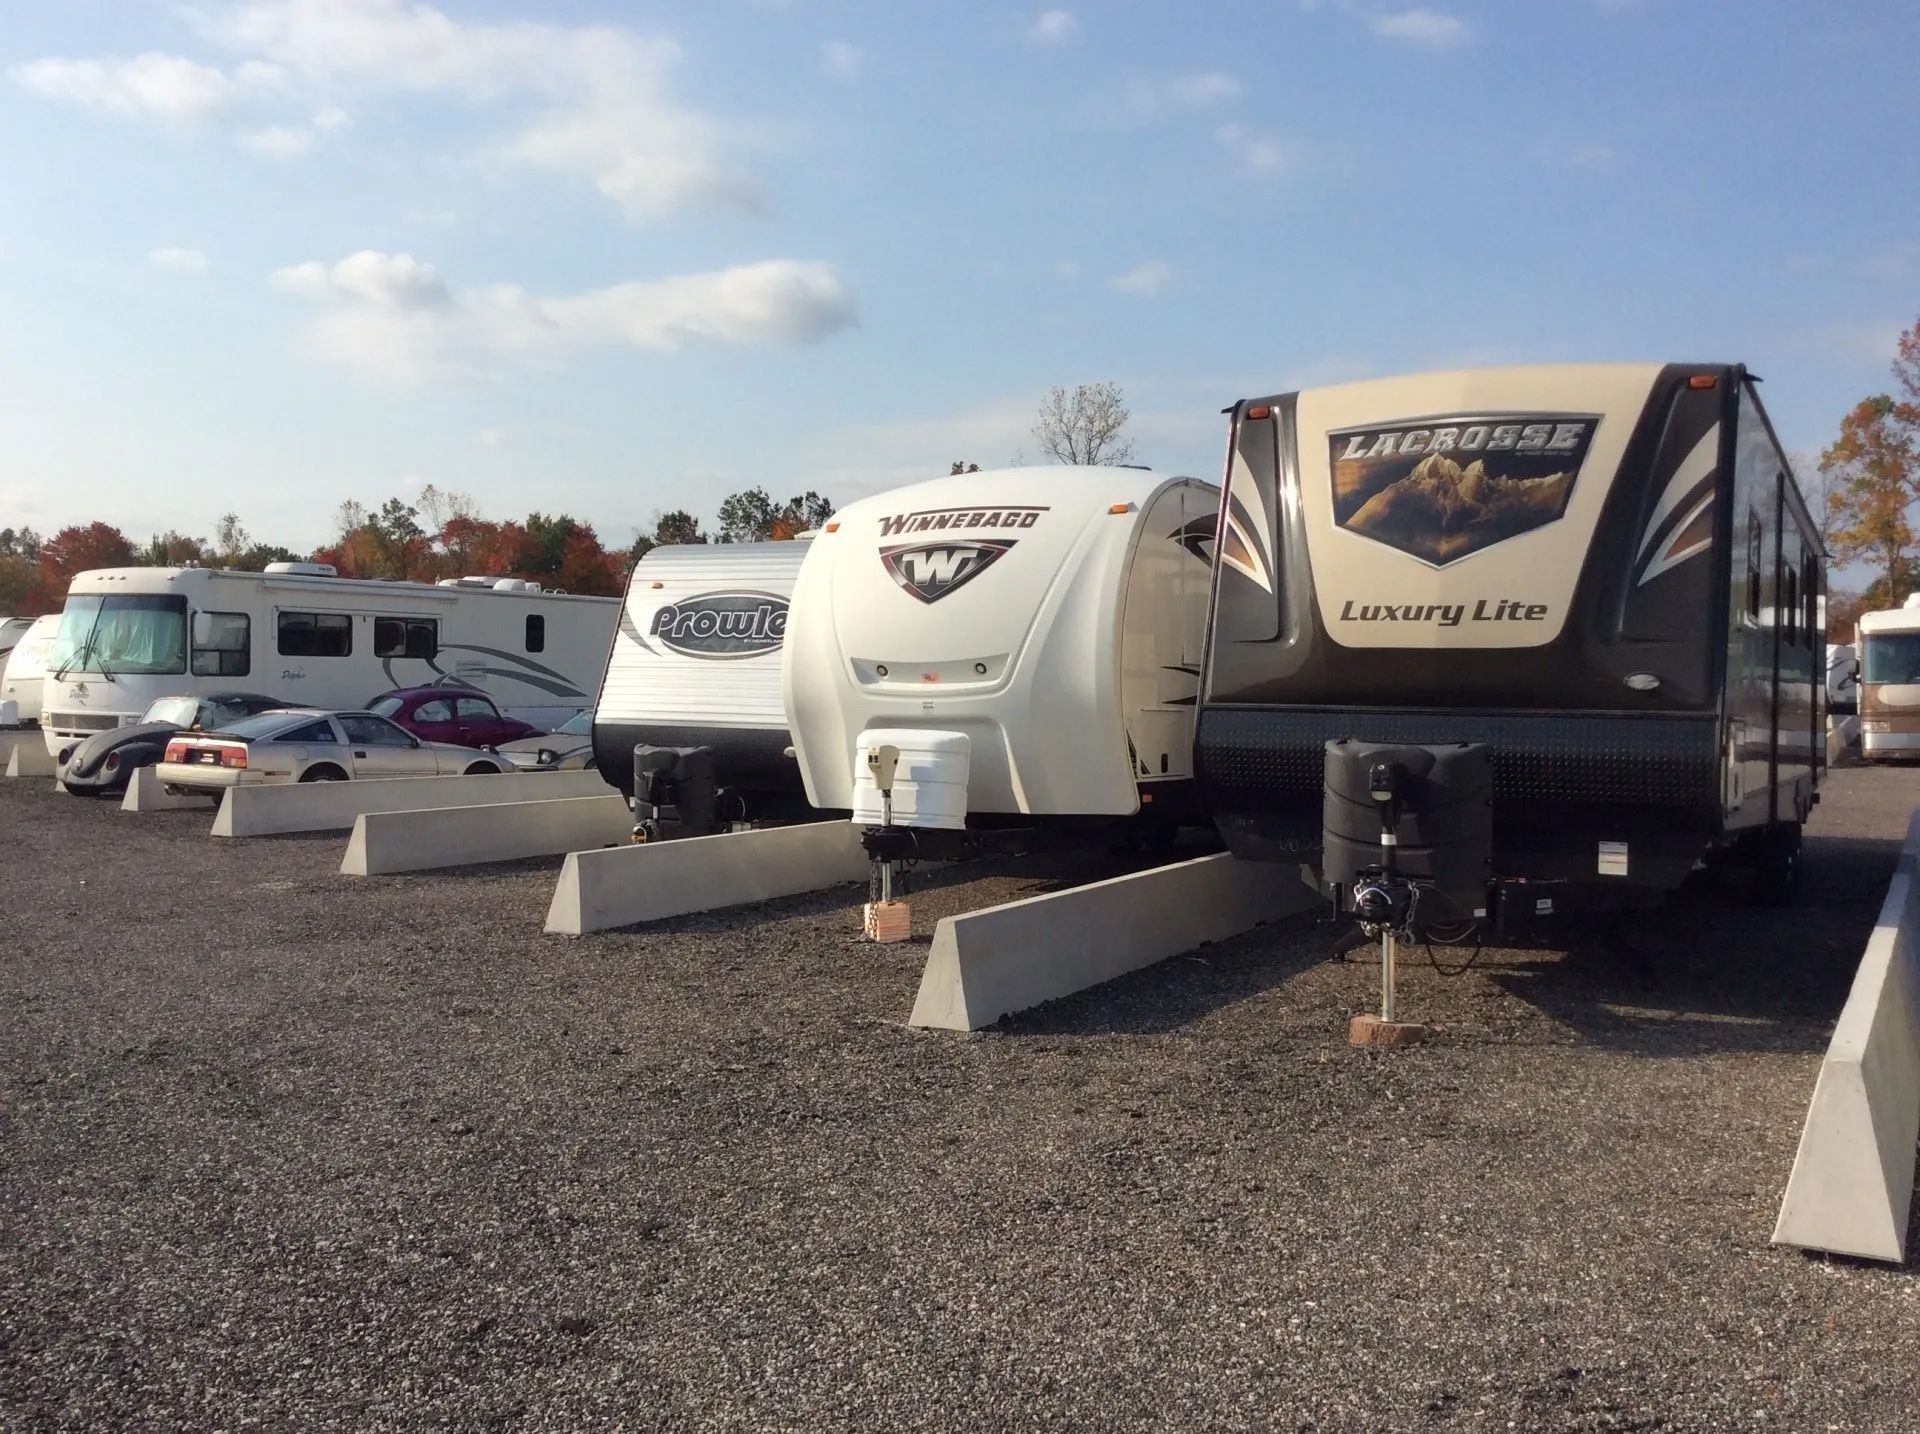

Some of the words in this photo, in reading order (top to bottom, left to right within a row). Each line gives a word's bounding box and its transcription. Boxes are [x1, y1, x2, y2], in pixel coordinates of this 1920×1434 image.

[1340, 424, 1585, 459] LACROSSE
[878, 511, 1041, 537] WINNEBAGO
[902, 549, 979, 586] W
[649, 605, 788, 638] Prowle
[1340, 600, 1465, 626] Luxury
[1472, 599, 1548, 621] Lite
